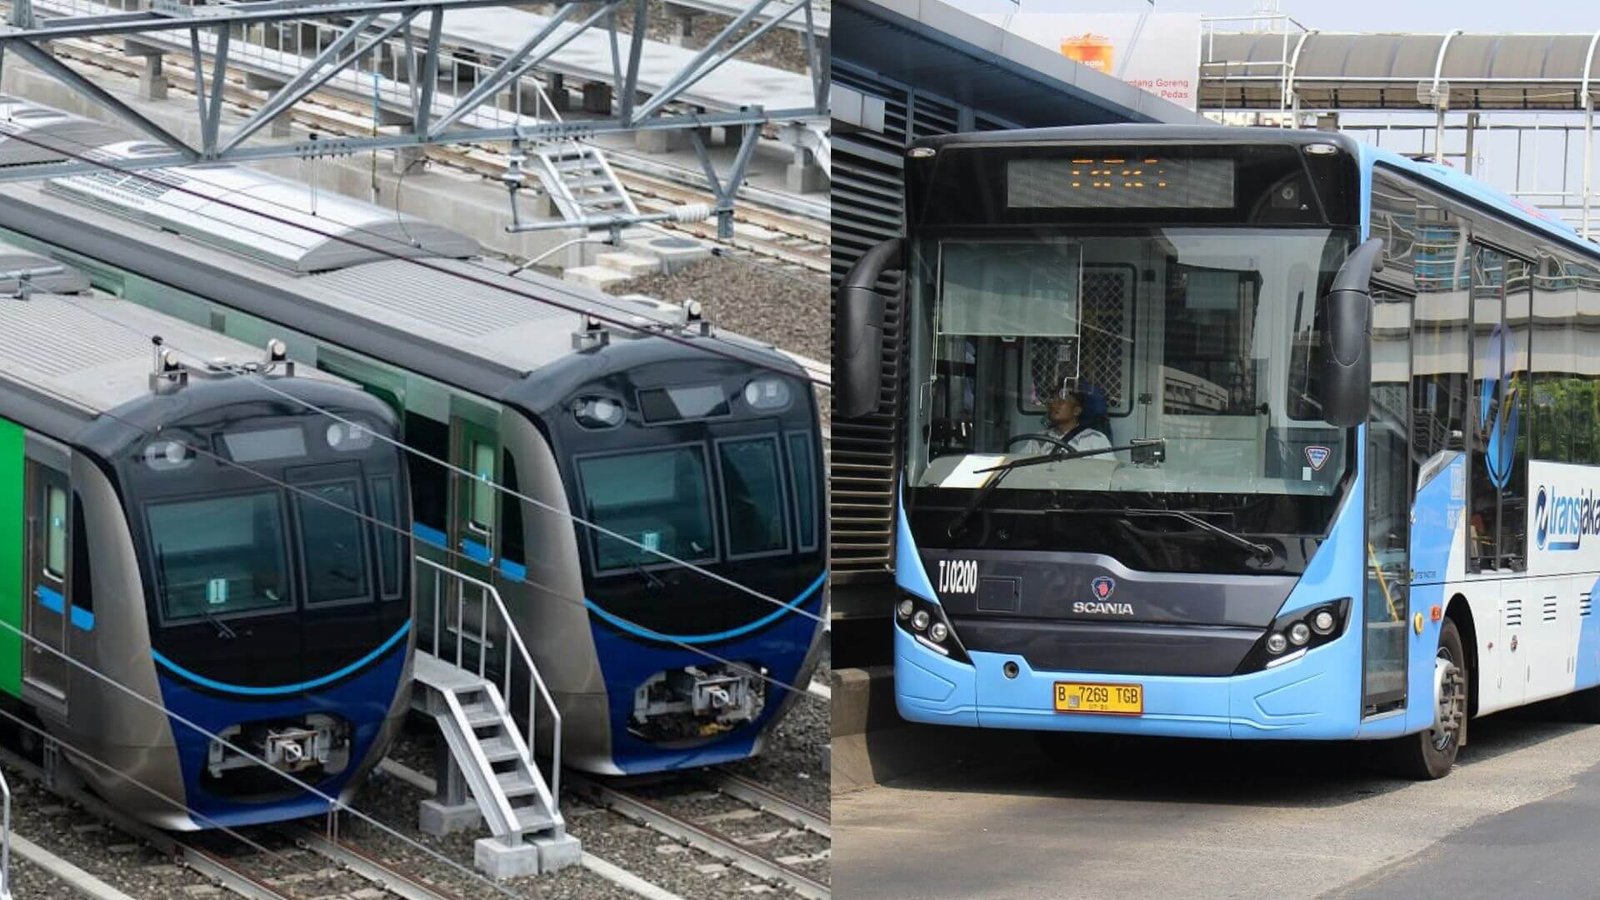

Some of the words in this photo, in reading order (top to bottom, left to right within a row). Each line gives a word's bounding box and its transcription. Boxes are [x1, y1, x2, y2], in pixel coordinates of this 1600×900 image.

[1156, 78, 1189, 89] Goreng
[1161, 90, 1188, 99] Pedas
[939, 560, 977, 594] TJ0200
[1072, 601, 1134, 616] SCANIA
[1058, 686, 1066, 701] B
[1079, 686, 1109, 703] 7269
[1116, 687, 1138, 704] TGB
